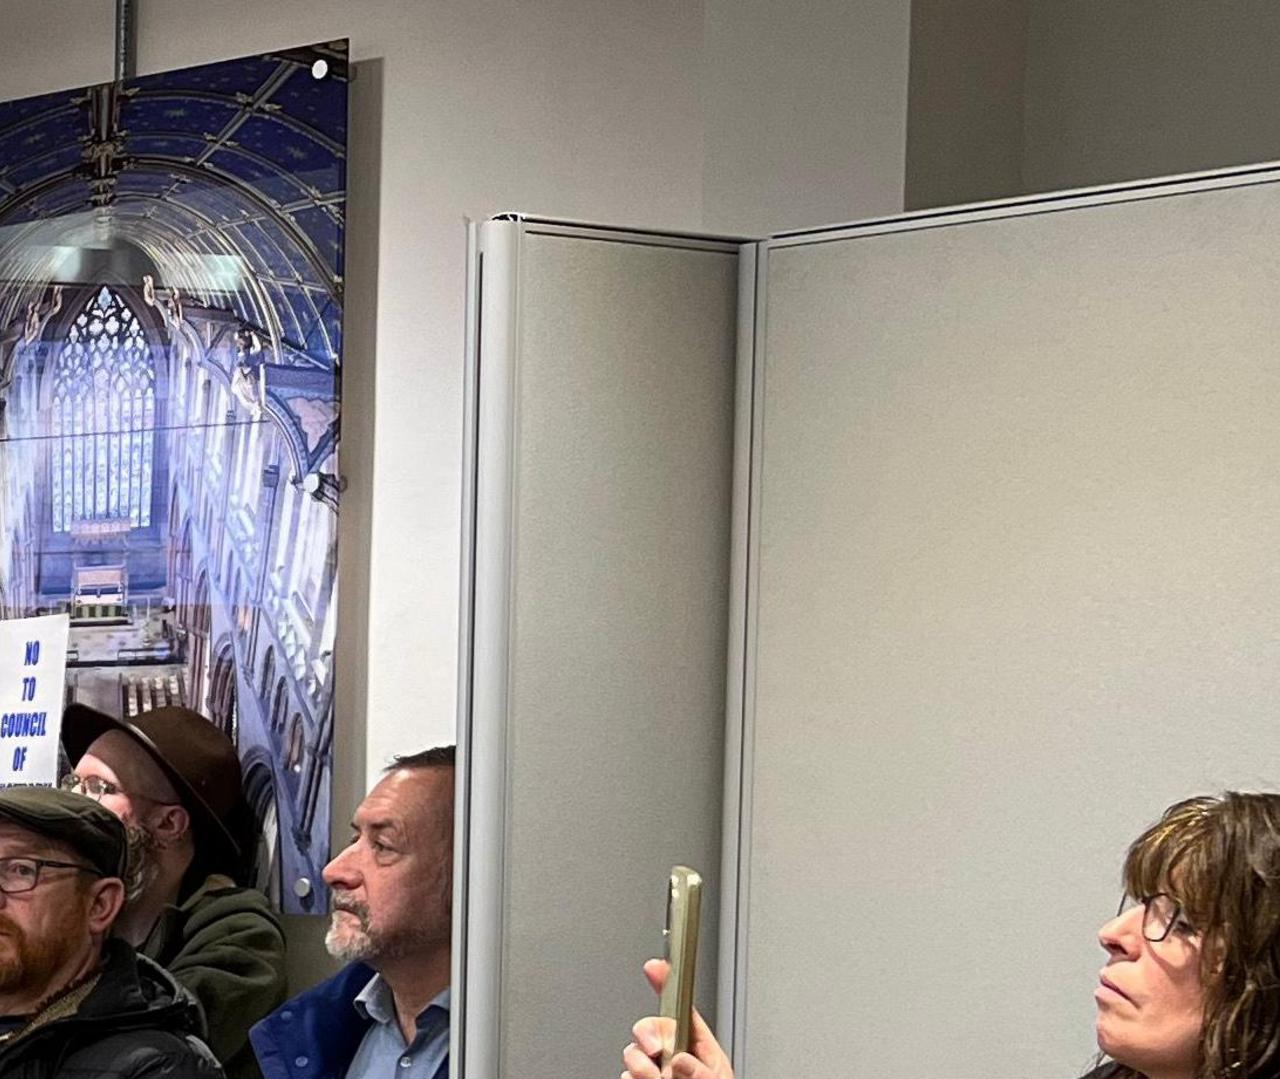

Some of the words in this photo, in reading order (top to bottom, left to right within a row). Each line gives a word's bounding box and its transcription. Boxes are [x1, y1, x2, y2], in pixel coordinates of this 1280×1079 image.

[24, 640, 40, 666] NO
[22, 677, 37, 701] TO
[0, 711, 47, 738] COUNCIL
[12, 746, 27, 771] OF
